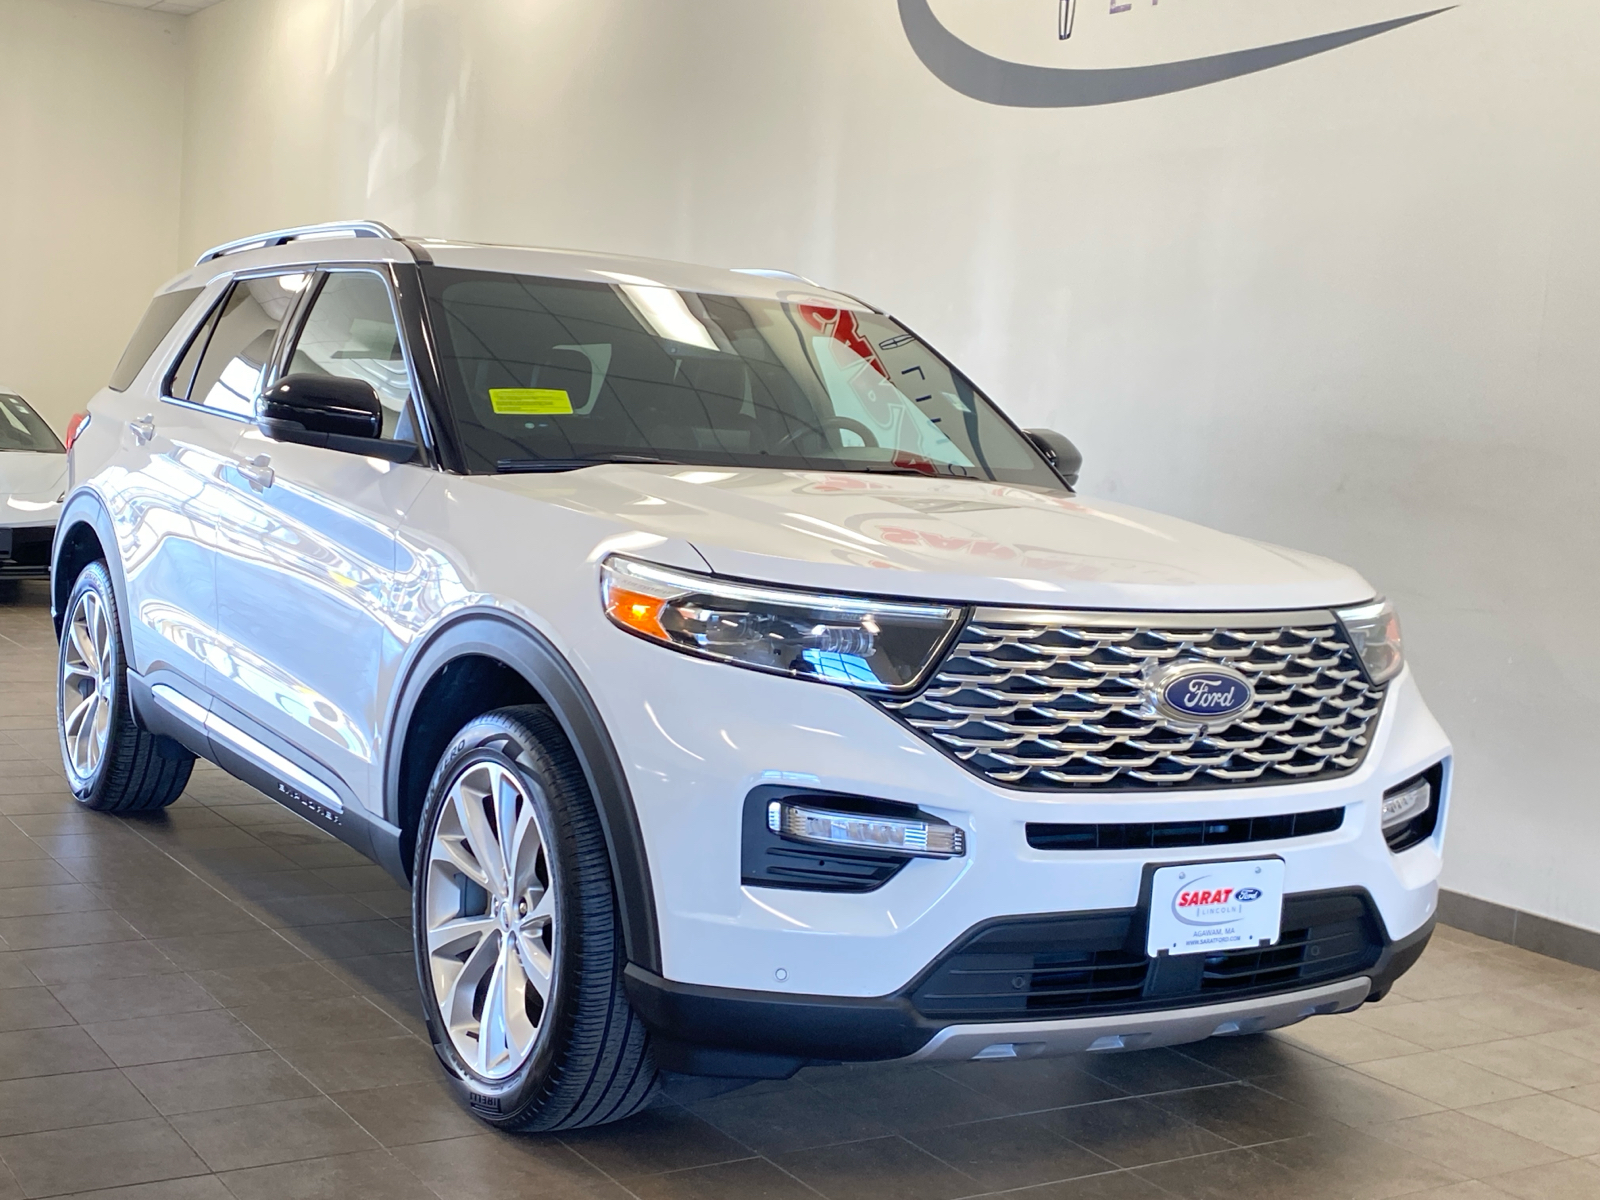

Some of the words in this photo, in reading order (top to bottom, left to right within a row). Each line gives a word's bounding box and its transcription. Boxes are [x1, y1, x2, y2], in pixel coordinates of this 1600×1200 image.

[1184, 679, 1235, 708] Ford
[1179, 888, 1233, 908] SARAT
[1238, 888, 1260, 901] Ford
[1202, 906, 1237, 915] LINCOLN
[1186, 936, 1241, 945] WWW.SARATFORD.COM
[470, 1092, 502, 1113] PIRELLI
